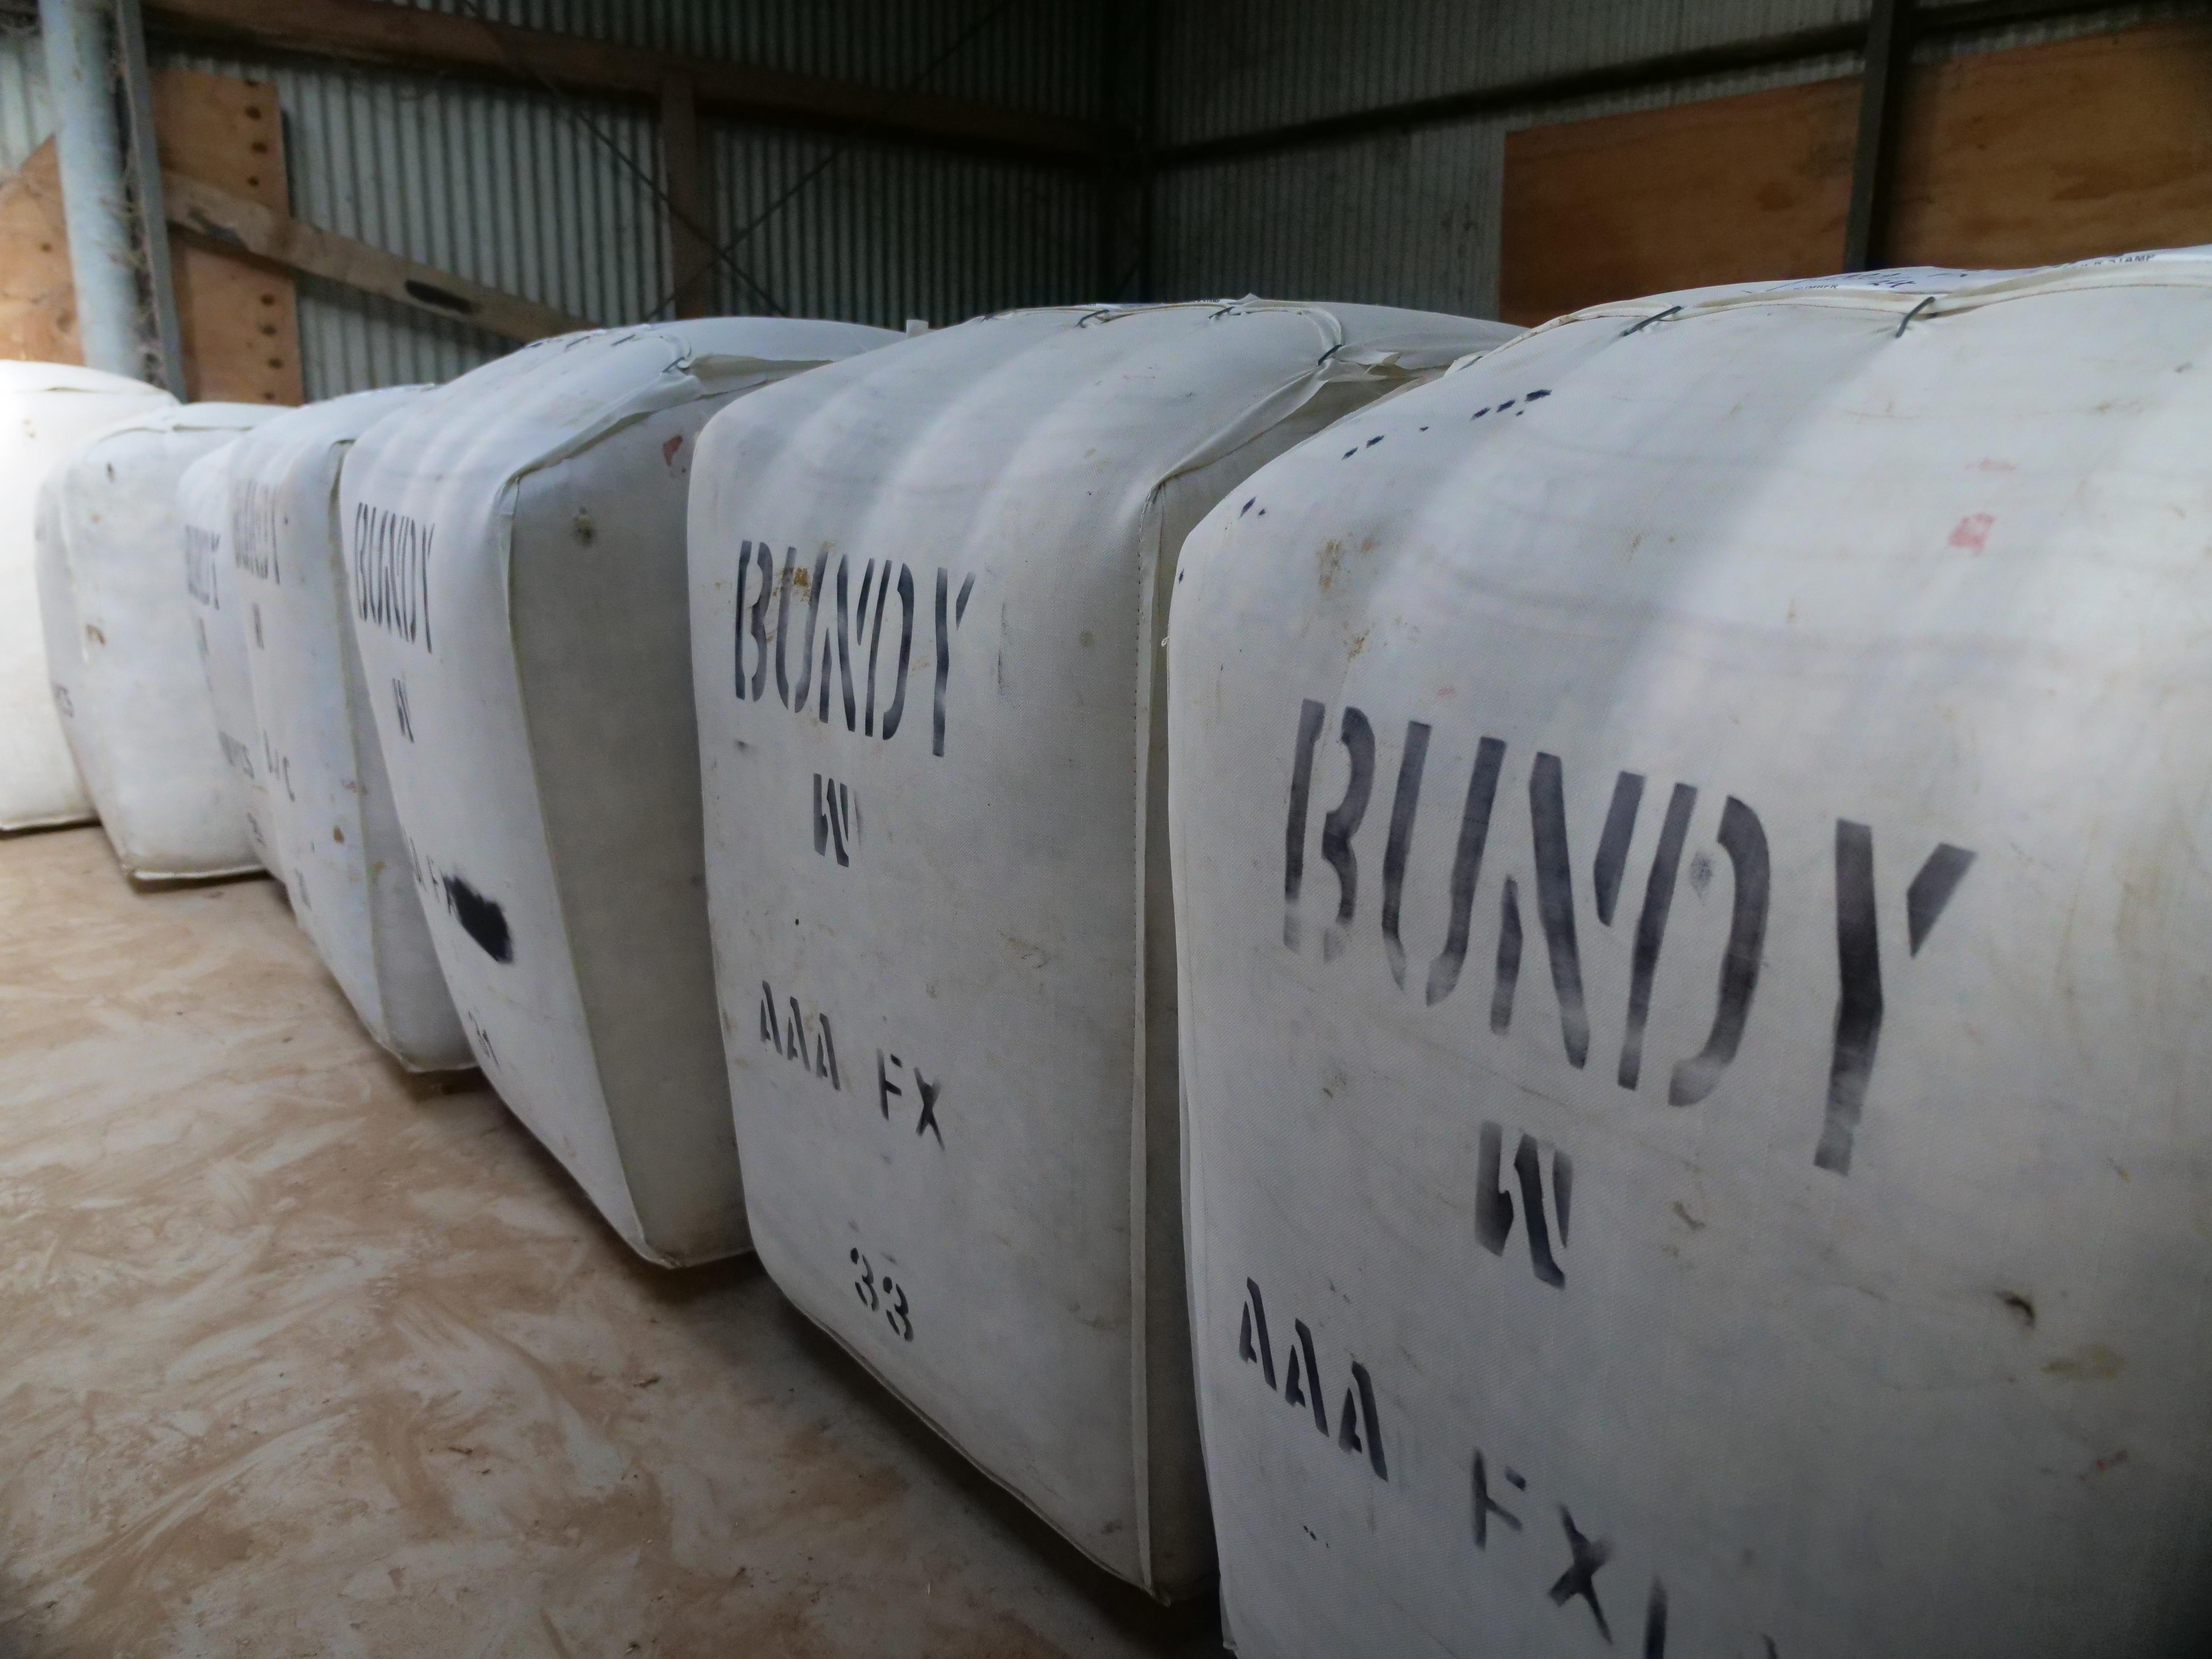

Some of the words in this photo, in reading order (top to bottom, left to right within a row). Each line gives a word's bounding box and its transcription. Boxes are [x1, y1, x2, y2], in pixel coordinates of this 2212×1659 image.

[734, 540, 976, 757] BUNDY
[1283, 698, 1978, 1177] BUNDY
[760, 979, 841, 1092] AAA
[876, 1047, 945, 1151] FX
[849, 1246, 914, 1342] 33
[1238, 1275, 1390, 1482] AAA
[1470, 1446, 1615, 1645] FX
